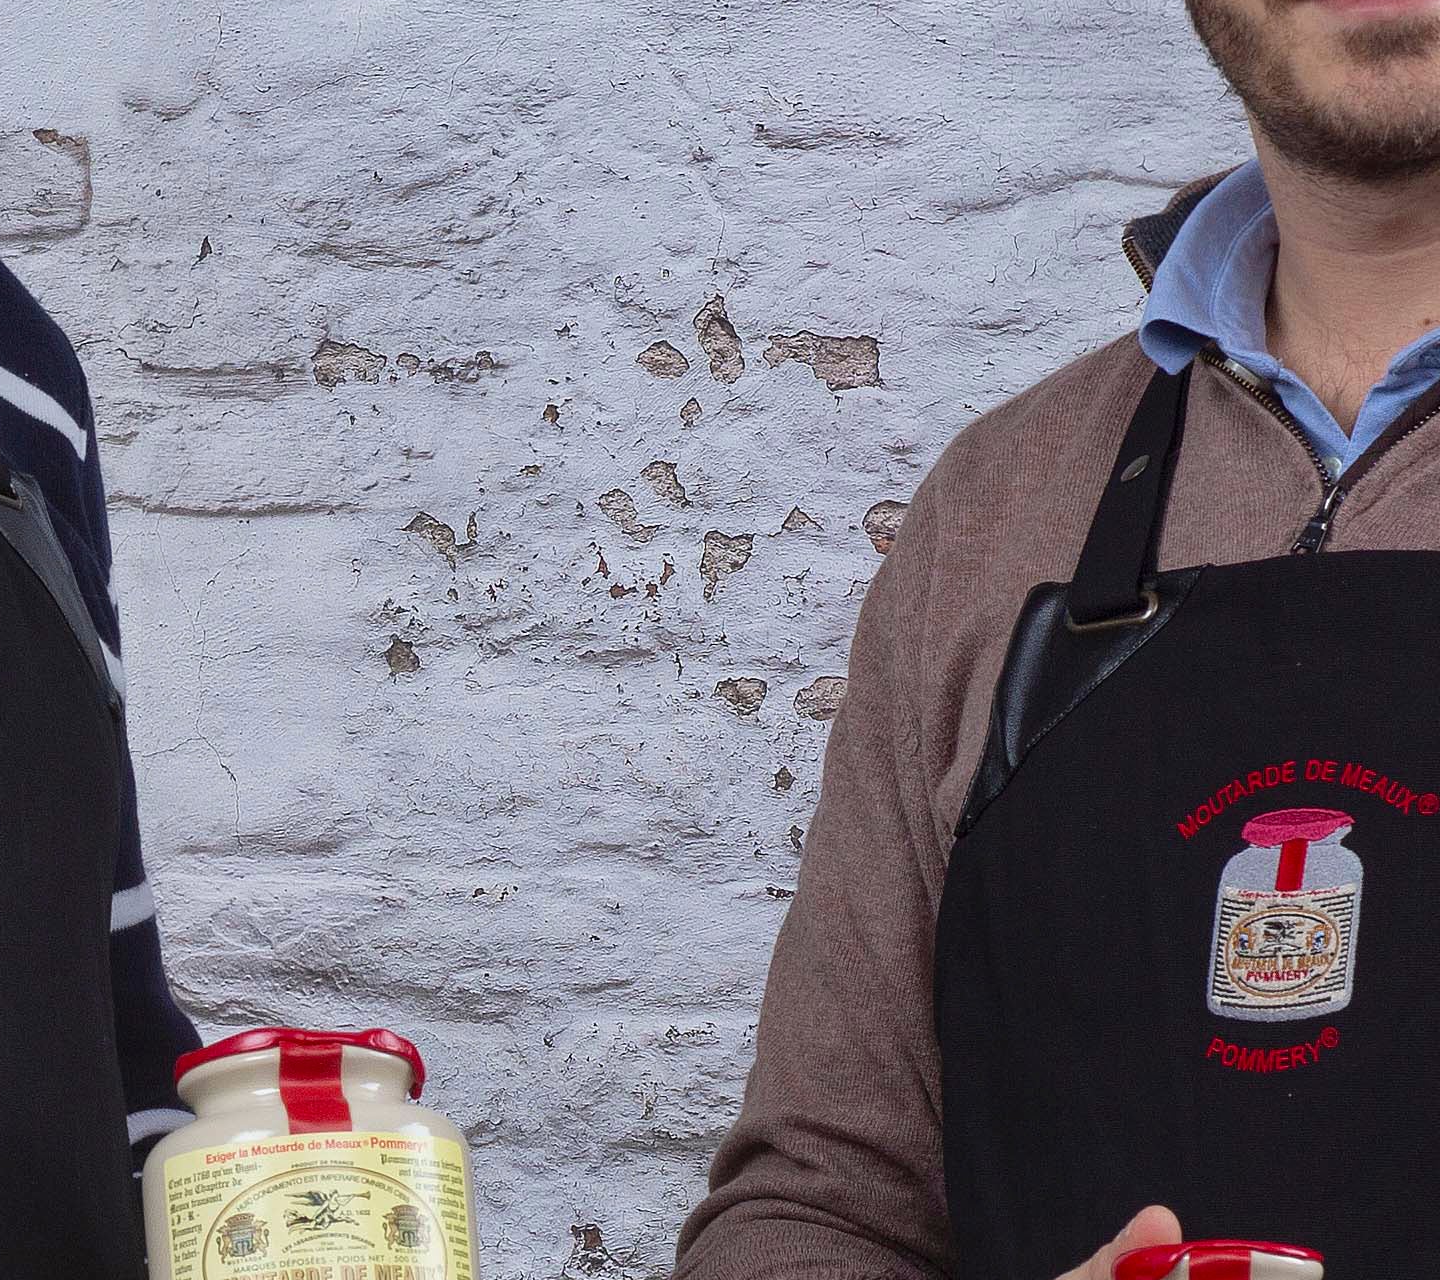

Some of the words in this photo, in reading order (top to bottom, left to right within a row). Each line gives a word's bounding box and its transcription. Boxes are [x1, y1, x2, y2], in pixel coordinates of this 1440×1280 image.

[1177, 761, 1297, 840] MOUTARDE
[1305, 759, 1339, 783] DE
[205, 1151, 237, 1165] Exiger
[239, 1149, 249, 1158] la
[251, 1139, 304, 1156] Moutarde
[308, 1139, 323, 1150] de
[304, 1175, 318, 1183] EST
[234, 1261, 277, 1273] MARQUES
[280, 1257, 326, 1268] DÉPOSÉES
[337, 1255, 365, 1263] POIDS
